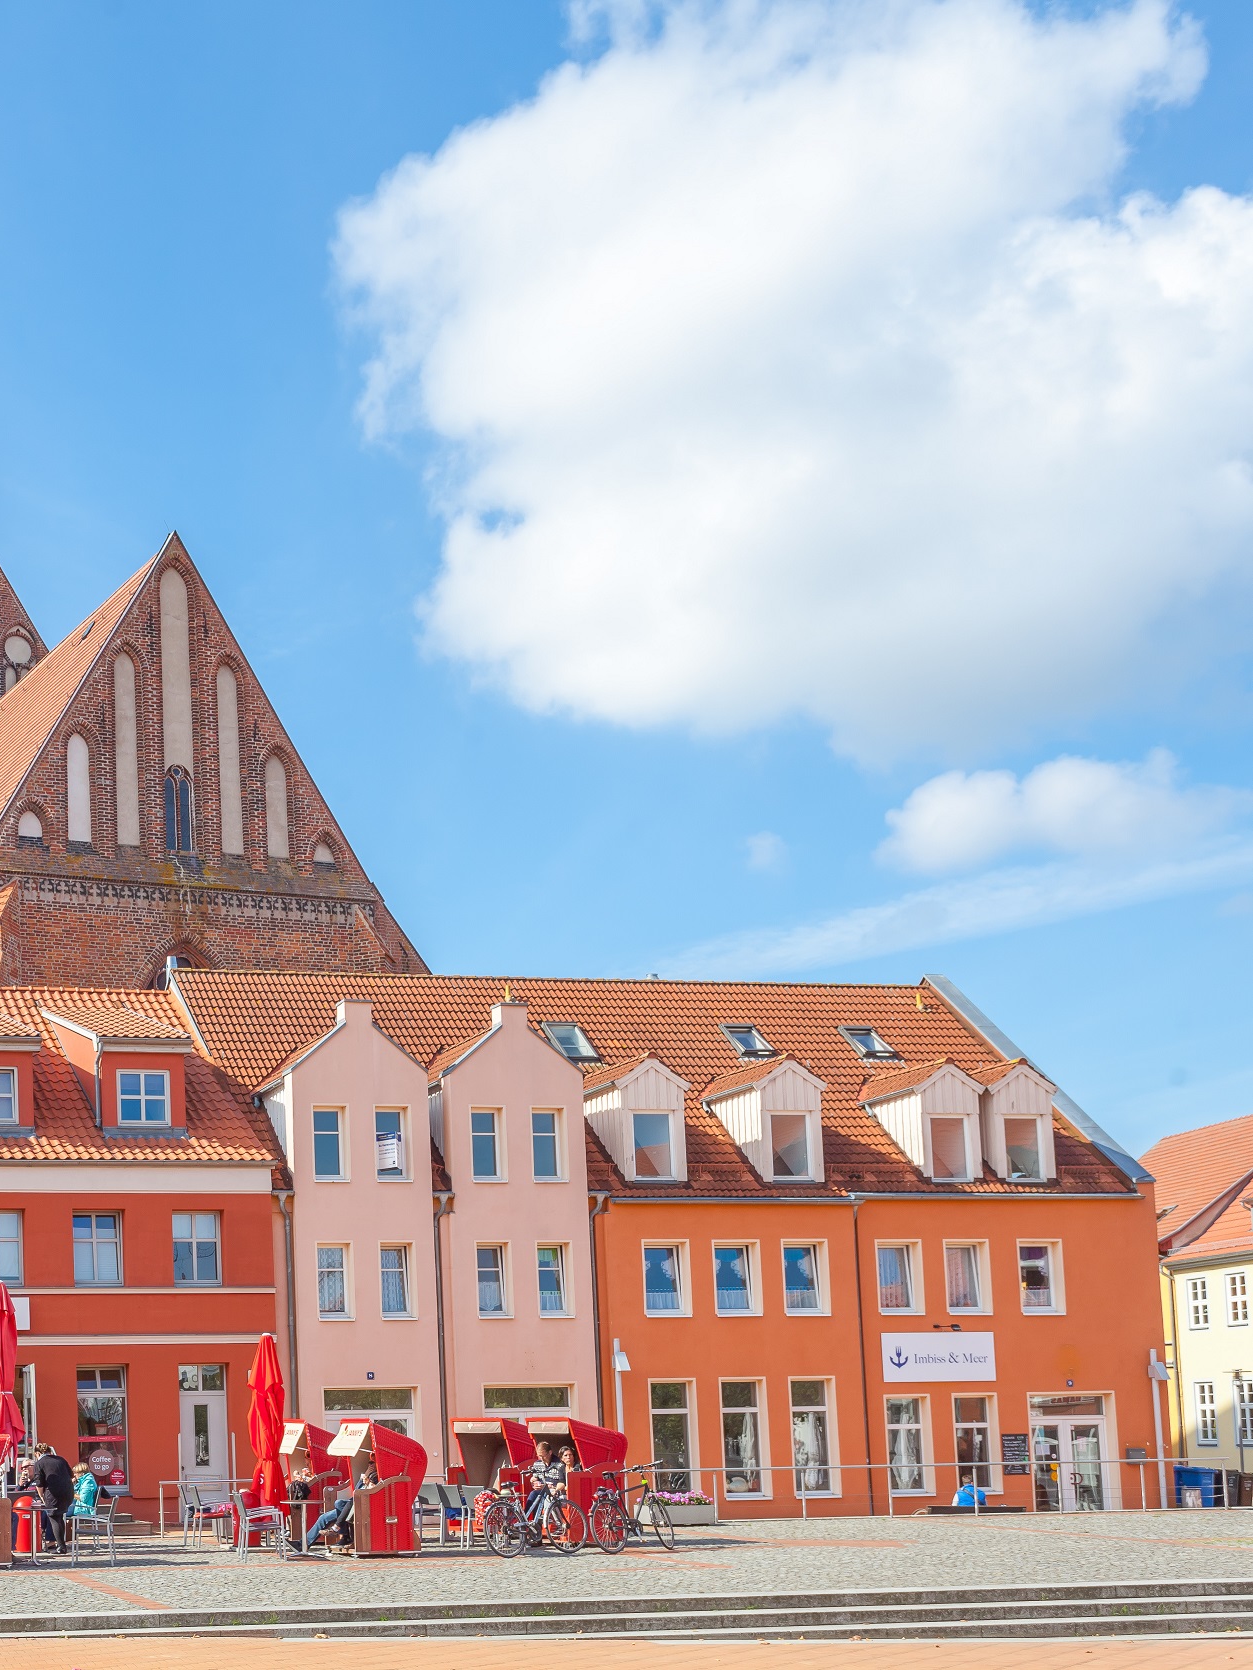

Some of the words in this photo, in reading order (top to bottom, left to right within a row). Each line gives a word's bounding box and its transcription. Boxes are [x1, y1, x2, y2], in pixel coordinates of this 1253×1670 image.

[914, 1353, 946, 1364] Imbiss
[948, 1352, 959, 1364] &
[962, 1353, 988, 1364] Meer
